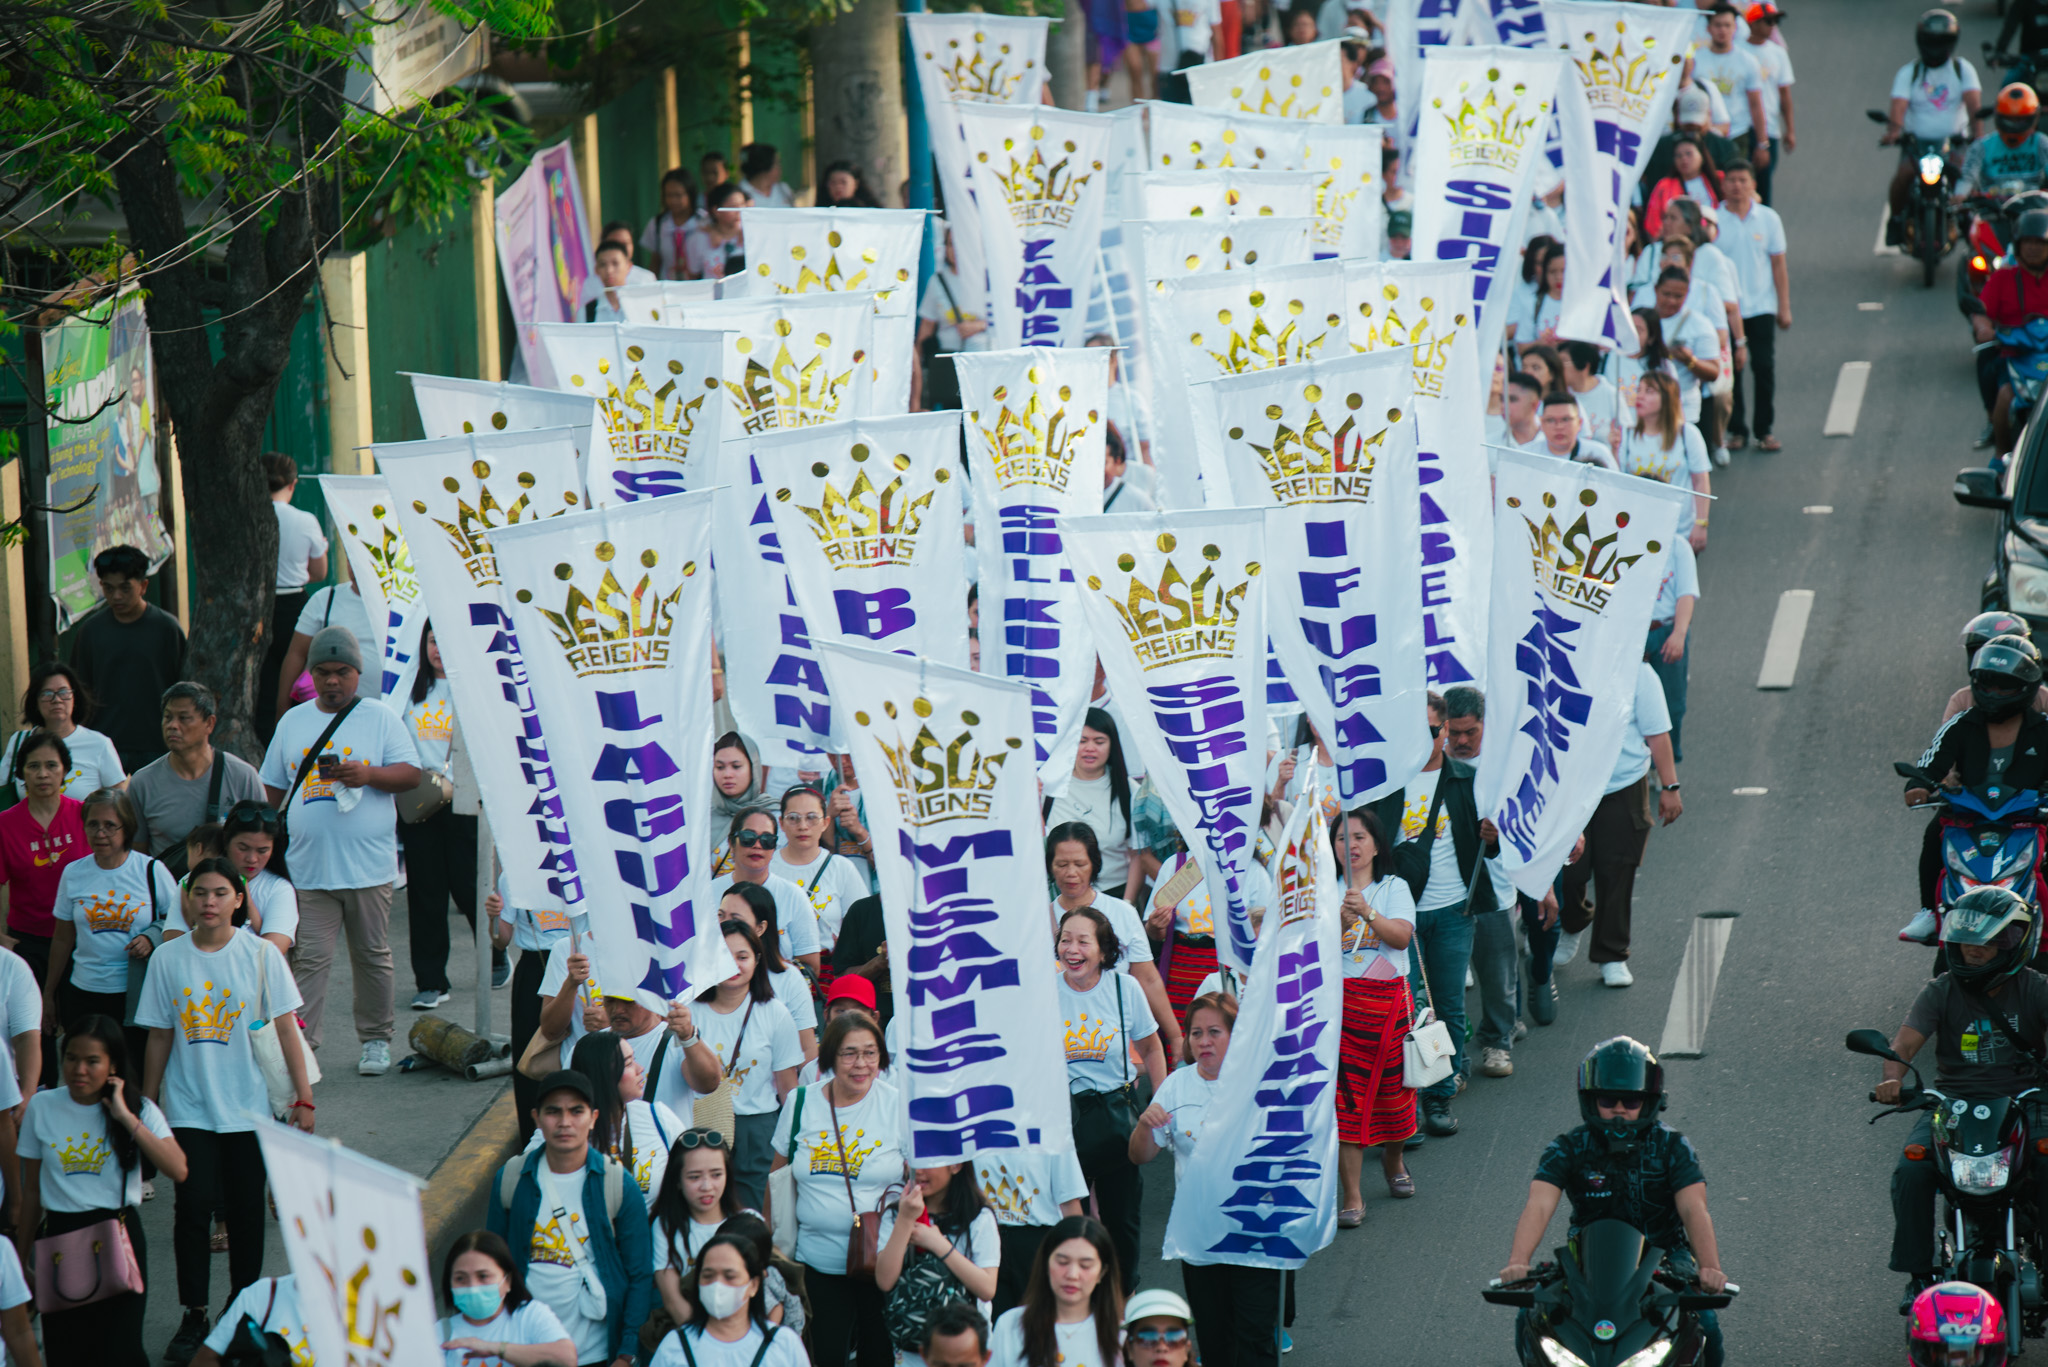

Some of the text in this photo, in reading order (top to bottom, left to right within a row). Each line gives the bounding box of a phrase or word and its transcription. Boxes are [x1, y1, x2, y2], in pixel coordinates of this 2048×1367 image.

[939, 51, 1023, 97] JESUS
[1571, 40, 1669, 100] JESUS
[1443, 88, 1537, 149] JESUS
[1586, 90, 1650, 119] REIGNS
[1449, 143, 1520, 168] REIGNS
[991, 146, 1093, 206] JESUS
[1009, 202, 1075, 224] REIGNS
[722, 342, 854, 418] JESUS
[595, 365, 706, 437] JESUS
[608, 433, 691, 458] REIGNS
[980, 391, 1086, 466] JESUS
[1246, 407, 1390, 482] JESUS
[994, 457, 1071, 488] REGNS
[1271, 476, 1373, 502] REIGNS
[794, 467, 935, 543] JESUS
[821, 537, 917, 565] REIGNS
[1521, 511, 1645, 589] JESUS
[1104, 557, 1250, 642] JESUS
[1532, 558, 1612, 610] REIGNS
[536, 566, 686, 653] JESUS
[563, 639, 671, 673] REIGNS
[1131, 629, 1238, 665] REIGNS
[1298, 519, 1388, 800] IFUGAO
[897, 792, 994, 819] RIGNS
[30, 833, 74, 852] NIKE
[591, 689, 697, 1001] LAGUNA
[82, 898, 142, 924] JESUS
[898, 827, 1042, 1159] MISAMIS OR.
[180, 994, 243, 1031] JESUS
[185, 1028, 231, 1043] REIGNS
[1063, 1023, 1115, 1053] ESUS
[57, 1143, 112, 1172] JESUS
[809, 1159, 861, 1178] REIGS
